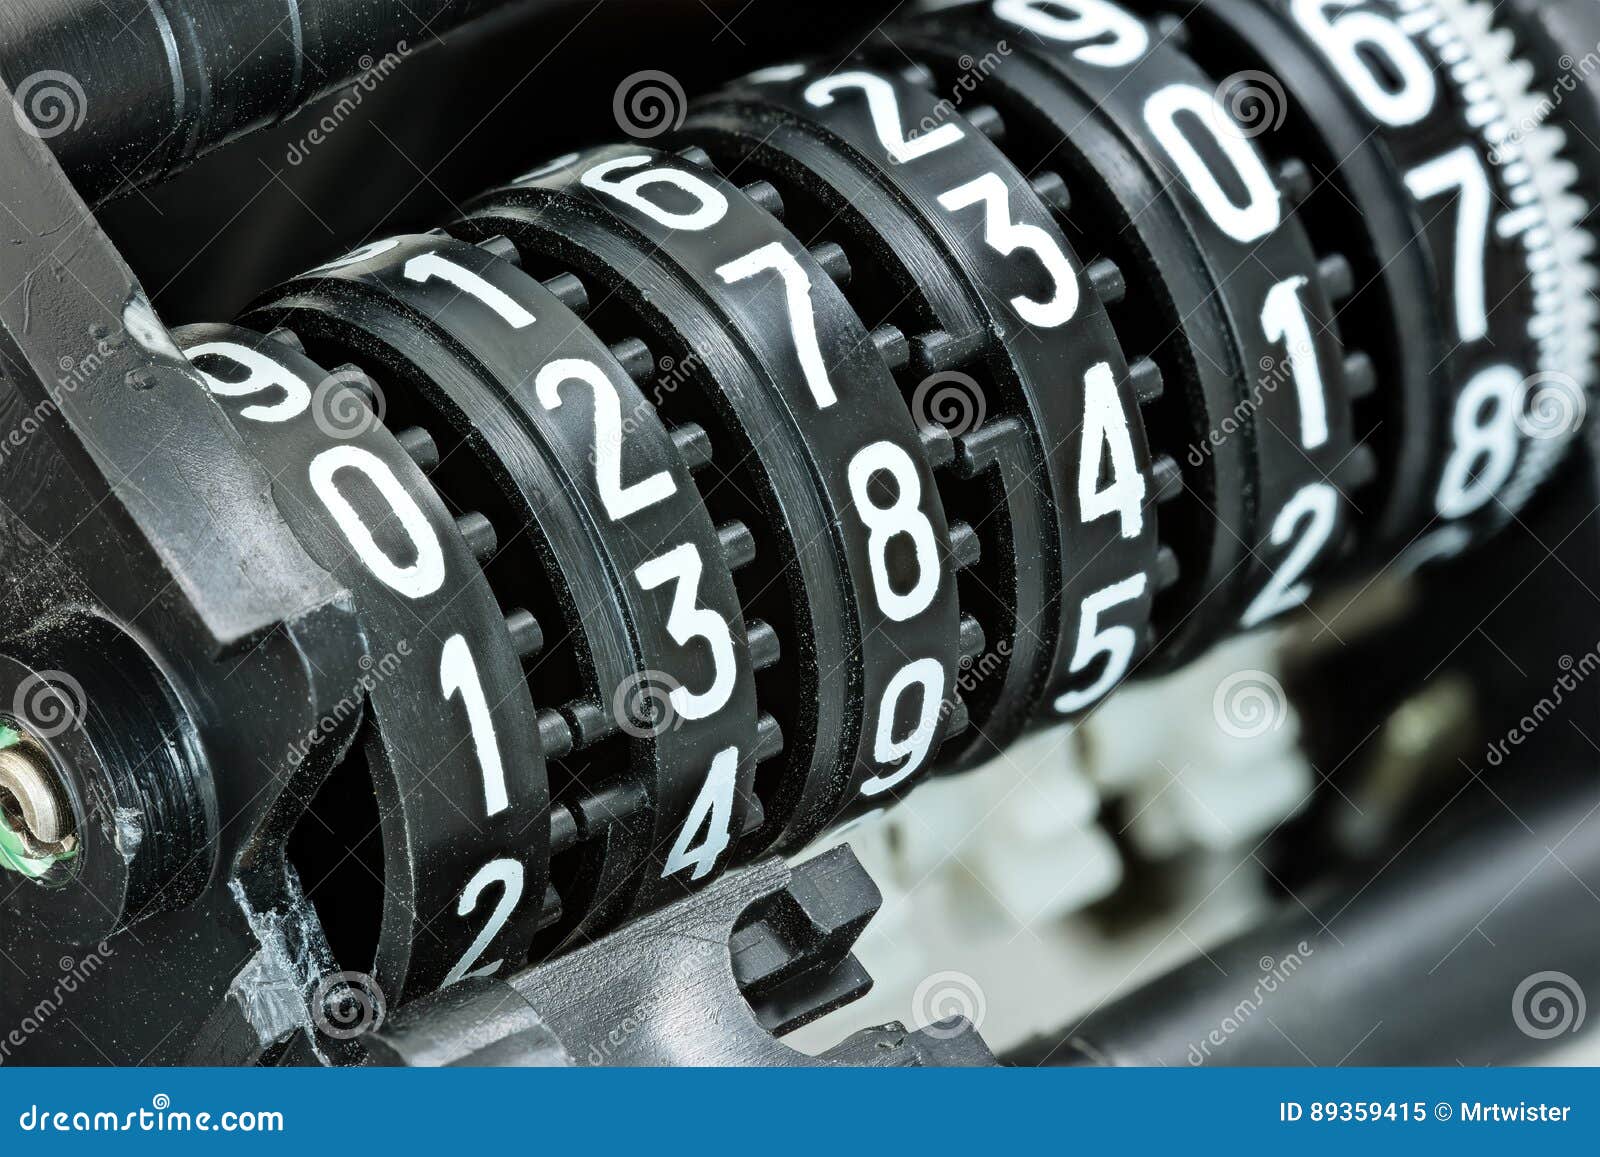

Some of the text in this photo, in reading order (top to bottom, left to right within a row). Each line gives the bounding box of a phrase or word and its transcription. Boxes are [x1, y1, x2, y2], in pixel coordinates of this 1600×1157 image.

[993, 0, 1150, 67] 9
[1291, 0, 1436, 127] 6
[581, 154, 729, 231] 6
[805, 72, 965, 164] 2
[1143, 82, 1281, 243] 0
[404, 251, 536, 328] 1
[937, 172, 1079, 328] 3
[1405, 147, 1489, 342] 7
[182, 342, 311, 423] 9
[715, 242, 838, 409] 7
[1261, 276, 1328, 449] 1
[535, 358, 677, 521] 2
[1079, 362, 1146, 538] 4
[1436, 365, 1523, 519] 8
[309, 445, 446, 599] 0
[848, 441, 941, 621] 8
[1242, 484, 1337, 626] 2
[635, 543, 737, 721] 3
[1055, 572, 1147, 713] 5
[440, 634, 509, 817] 1
[860, 658, 945, 796] 9
[661, 746, 739, 881] 4
[440, 858, 524, 985] 2
